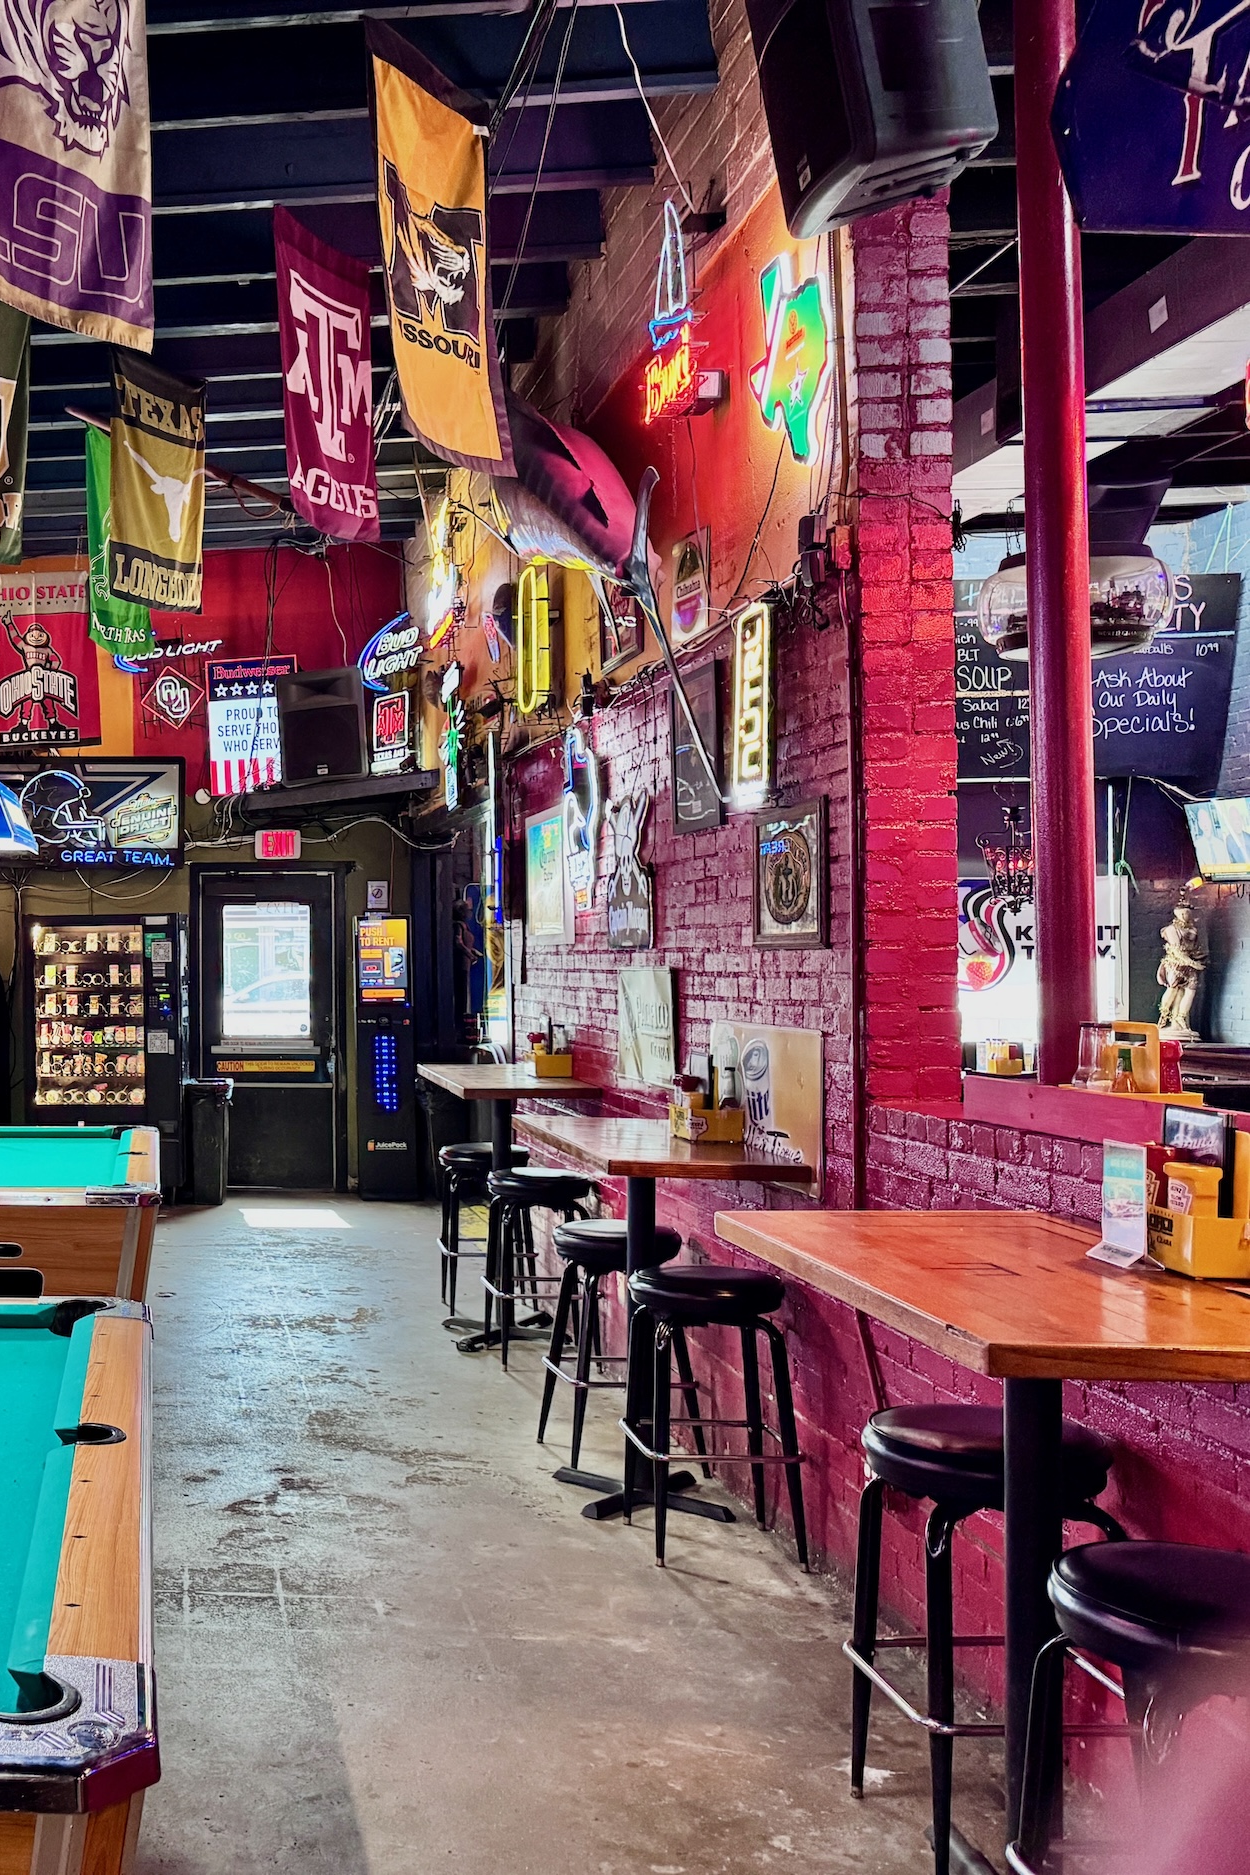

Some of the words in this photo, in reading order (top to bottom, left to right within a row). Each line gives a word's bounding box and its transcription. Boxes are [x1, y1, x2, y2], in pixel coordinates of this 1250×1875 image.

[115, 373, 203, 441] TEXAS
[36, 584, 85, 599] STATE
[166, 640, 222, 656] LIGHT
[376, 626, 419, 656] BUD
[957, 648, 980, 661] BLT
[365, 646, 423, 680] LIGHT
[213, 665, 290, 679] Budweiser
[957, 665, 1012, 691] SOUP
[1092, 668, 1132, 688] Ask
[1135, 667, 1193, 688] About
[963, 699, 999, 712] Salad
[1098, 691, 1125, 708] Our
[1132, 689, 1177, 714] Daily
[226, 707, 263, 721] PROUD
[218, 724, 252, 737] SERVE
[973, 716, 998, 730] Chili
[2, 730, 76, 742] BUCKEYES
[224, 740, 248, 752] WHO
[253, 738, 280, 750] SERV
[111, 806, 177, 828] GENUINE
[120, 817, 169, 835] DRAFT
[262, 831, 296, 858] EXIT
[61, 850, 117, 863] GREAT
[125, 850, 170, 866] TEAM
[360, 927, 383, 937] PUSH
[360, 937, 370, 946] TO
[373, 937, 394, 946] RENT
[217, 1061, 244, 1071] CAUTION
